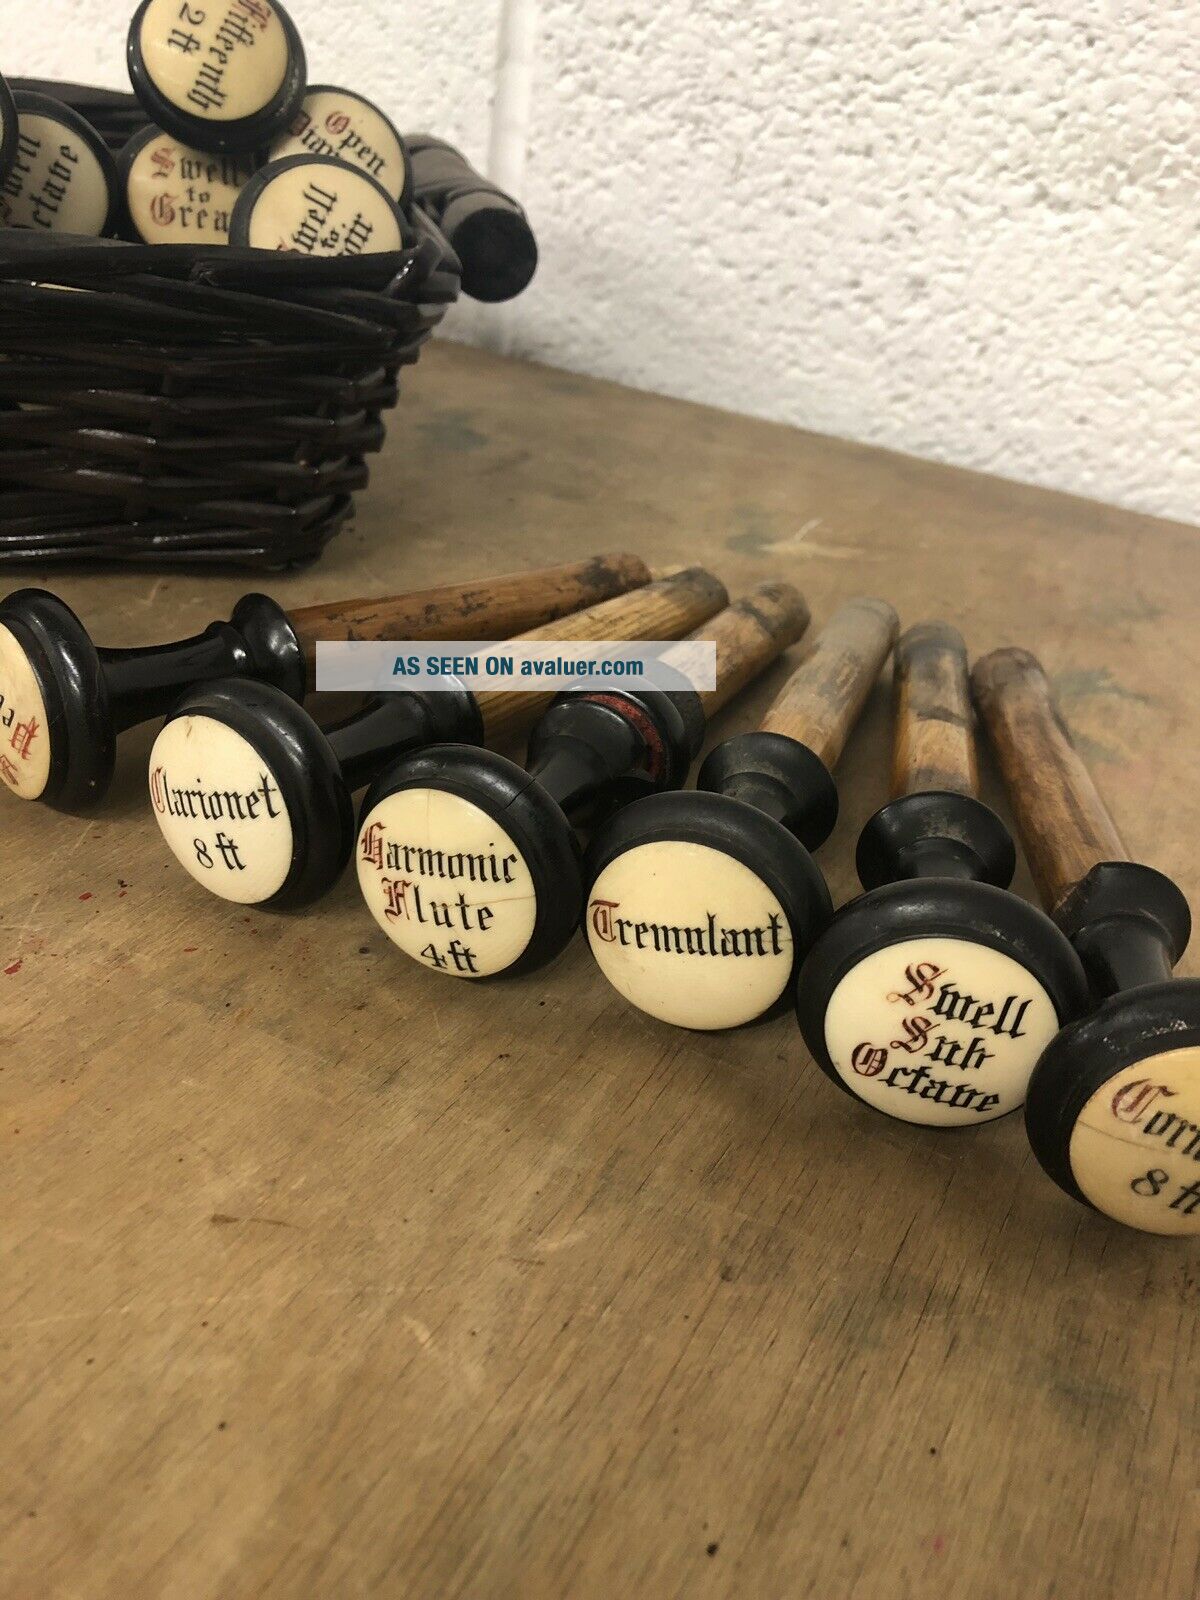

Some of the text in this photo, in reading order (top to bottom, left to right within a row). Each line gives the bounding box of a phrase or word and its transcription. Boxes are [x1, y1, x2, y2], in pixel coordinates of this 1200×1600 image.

[167, 2, 206, 54] 2 ft
[150, 148, 241, 188] Swell
[325, 111, 386, 176] Open
[186, 186, 211, 203] to
[277, 183, 337, 254] well
[320, 228, 340, 249] to
[150, 766, 281, 821] Clarionet
[193, 831, 247, 872] 8 ft
[361, 821, 519, 884] Harmonic
[382, 877, 494, 931] Flute
[588, 898, 784, 959] Tremulant
[420, 939, 479, 974] 4 ft
[886, 961, 1034, 1038] Swell
[891, 1015, 994, 1070] Sub
[850, 1041, 1000, 1113] Octave
[1130, 1167, 1170, 1198] 8
